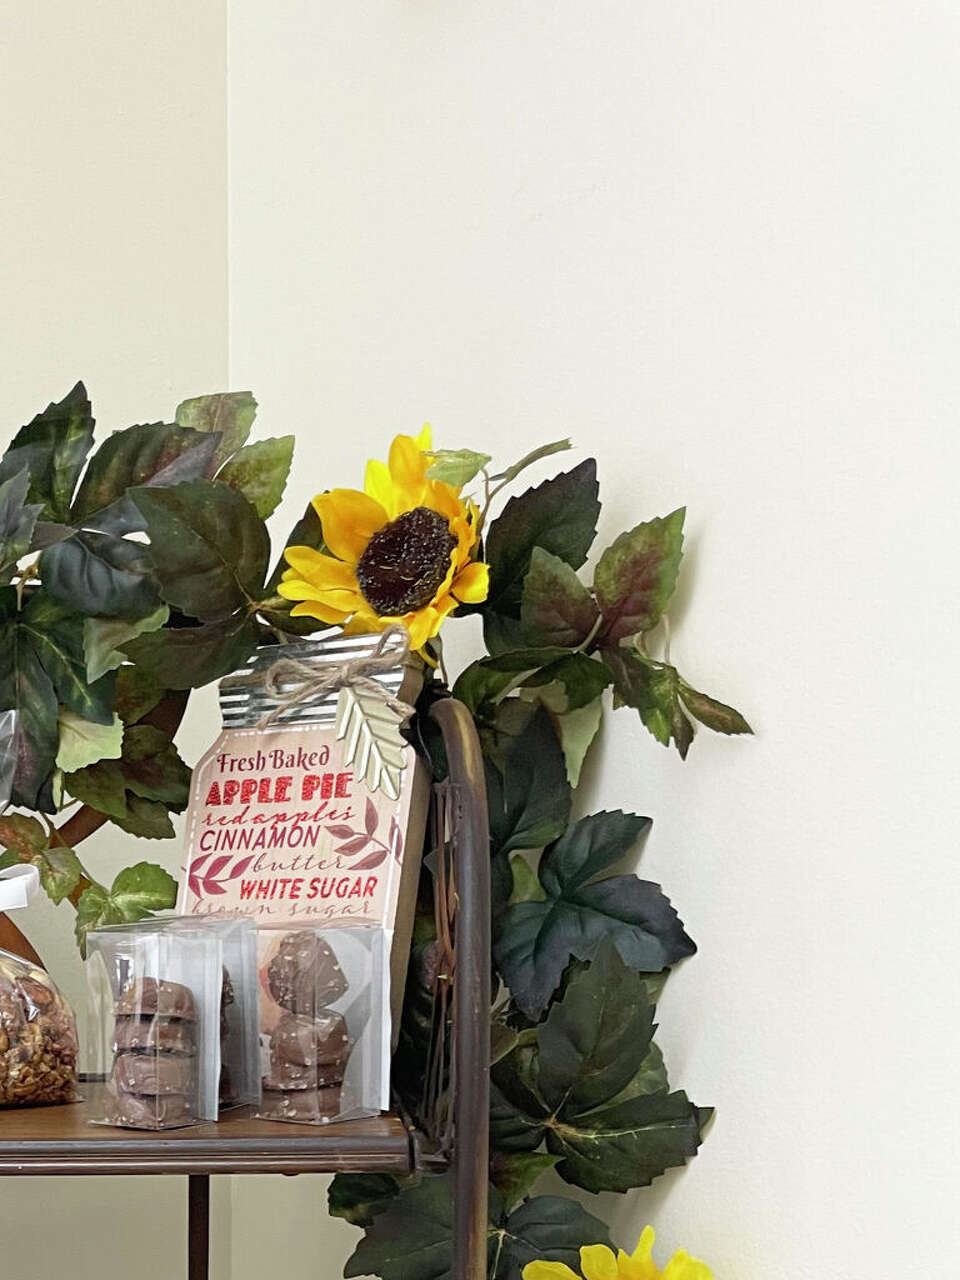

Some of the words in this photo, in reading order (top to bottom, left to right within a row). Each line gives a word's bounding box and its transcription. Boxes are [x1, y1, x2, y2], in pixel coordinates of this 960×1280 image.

[217, 750, 266, 773] Fresh
[268, 745, 330, 771] Baked
[205, 776, 293, 807] APPLE
[301, 772, 354, 801] PIE
[199, 824, 322, 852] CINNAMON
[250, 852, 350, 873] butter
[240, 878, 302, 901] WHITE
[307, 875, 379, 899] SUGAR
